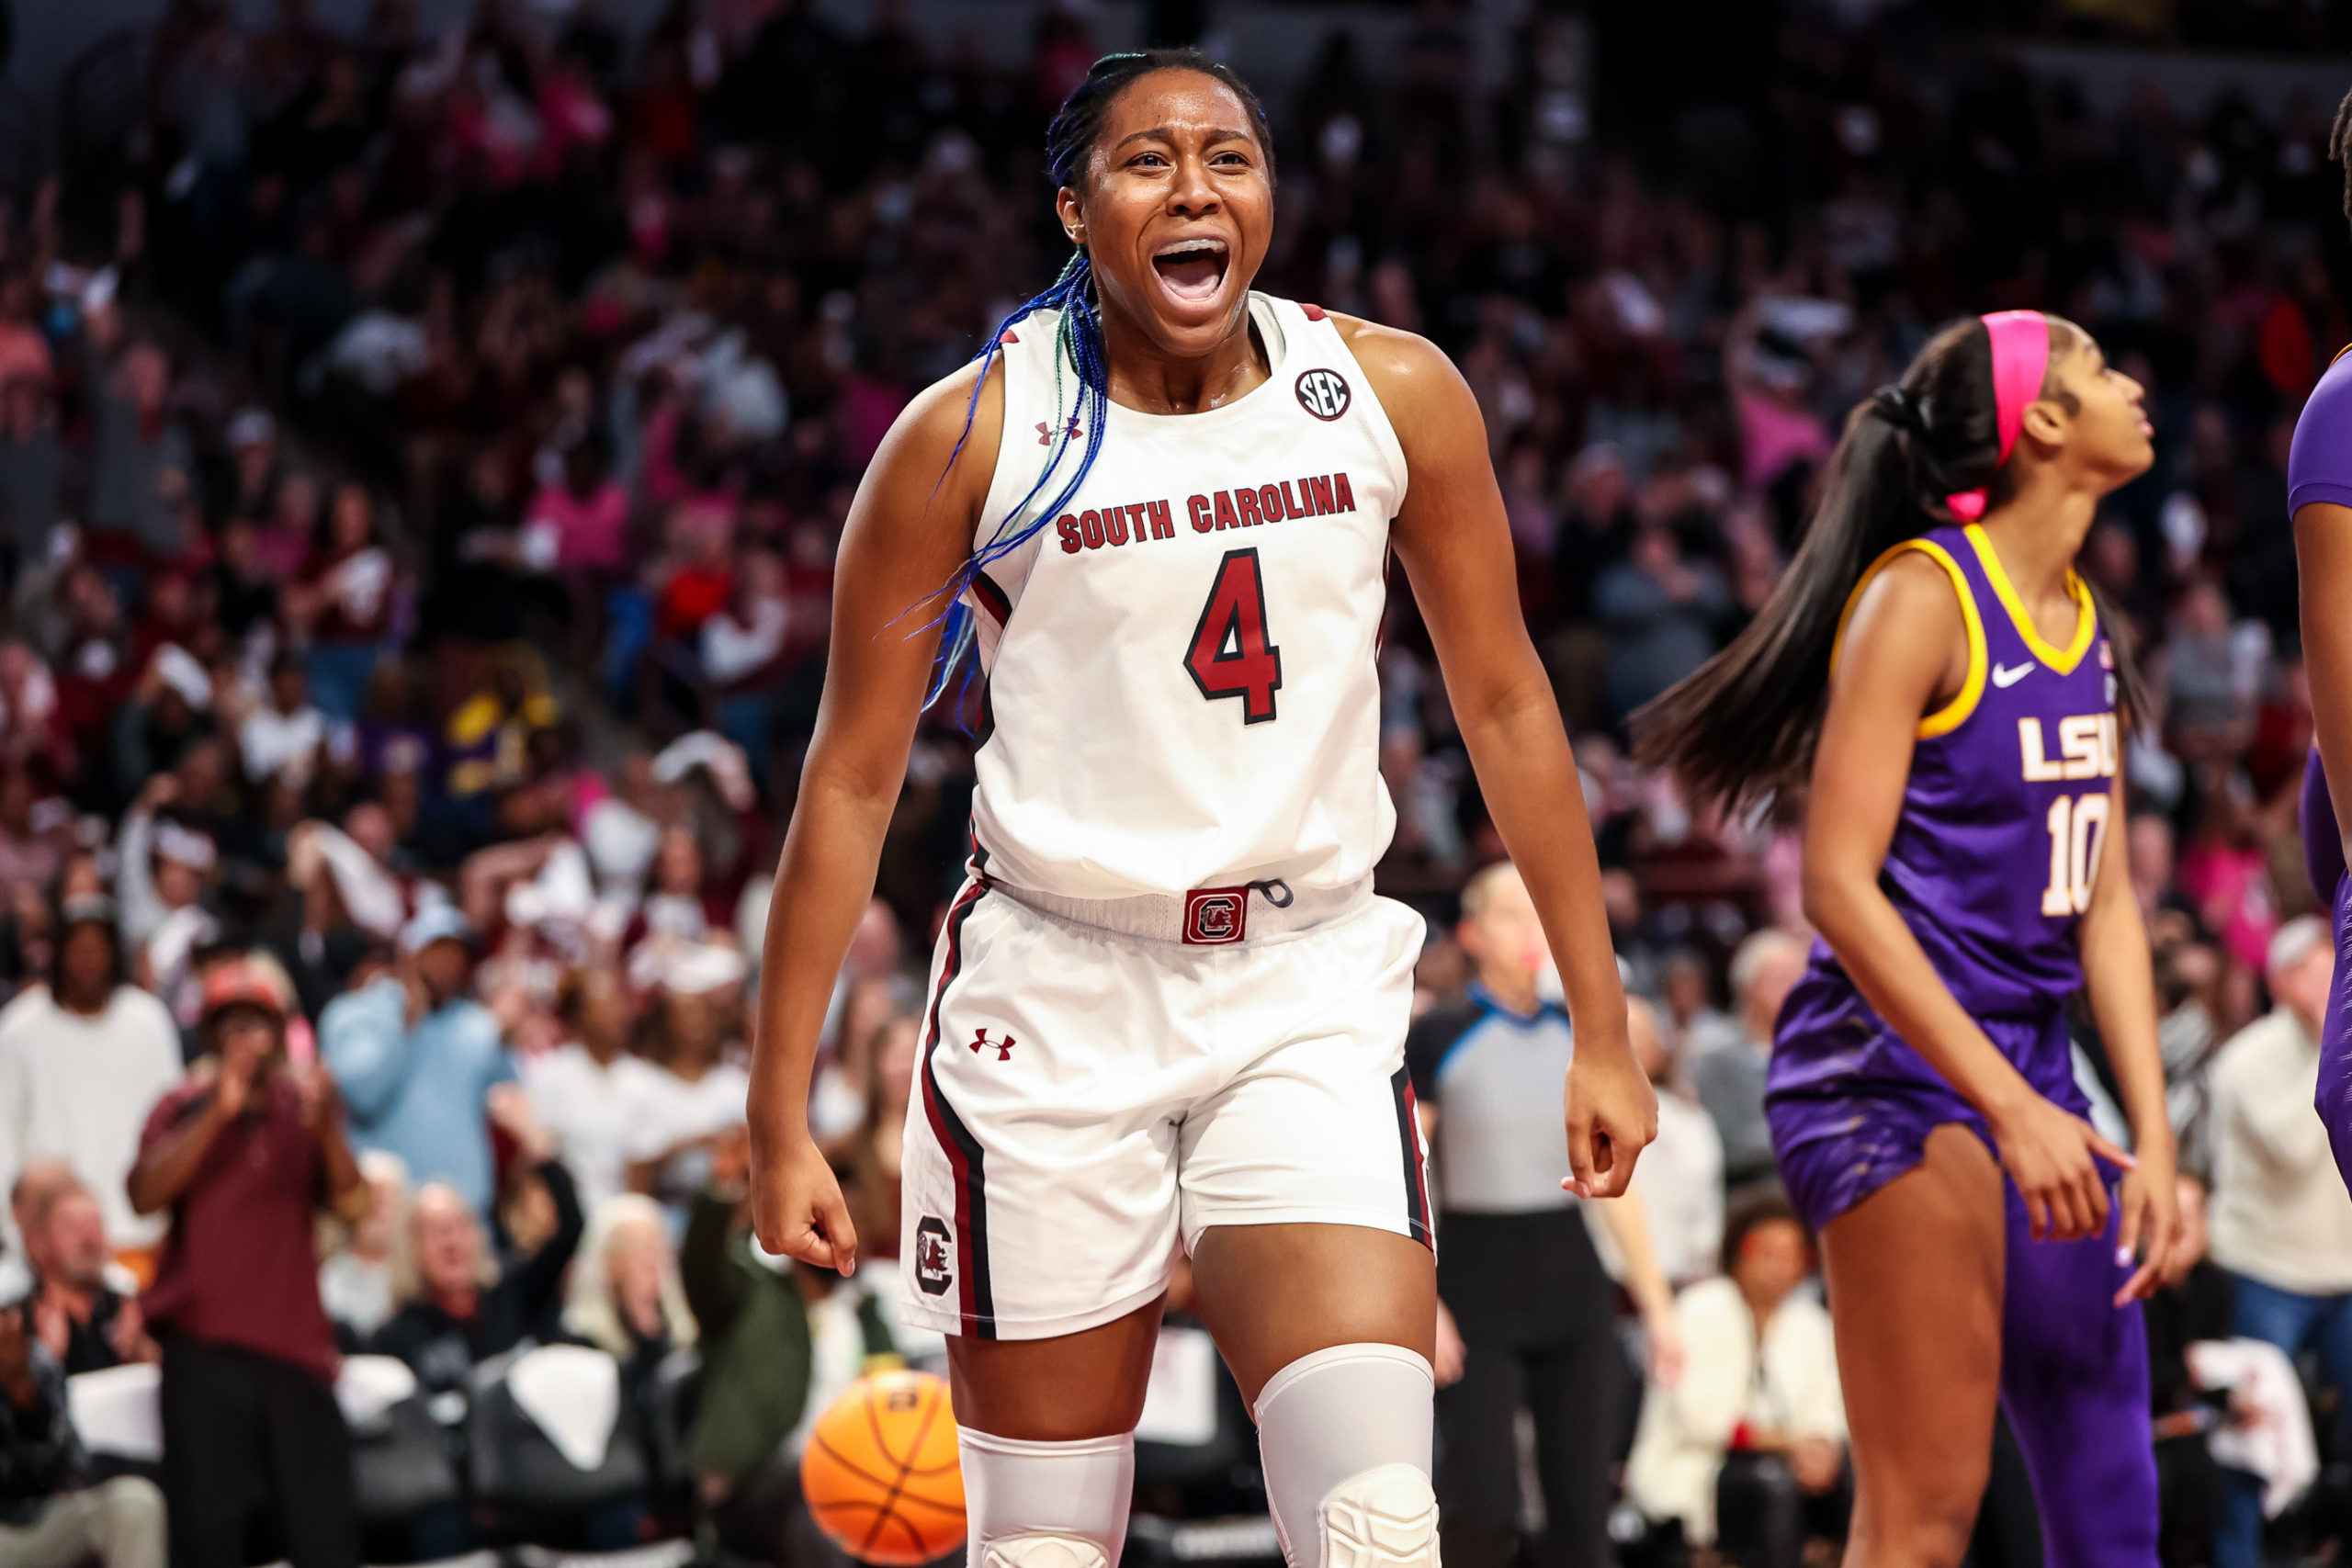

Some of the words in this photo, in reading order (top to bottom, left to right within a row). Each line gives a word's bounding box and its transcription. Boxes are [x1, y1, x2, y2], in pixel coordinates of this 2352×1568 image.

[1298, 371, 1348, 416] SEC
[1057, 499, 1176, 555] SOUTH
[1186, 472, 1357, 535] CAROLINA
[1183, 547, 1283, 726] 4
[2041, 792, 2110, 917] 10
